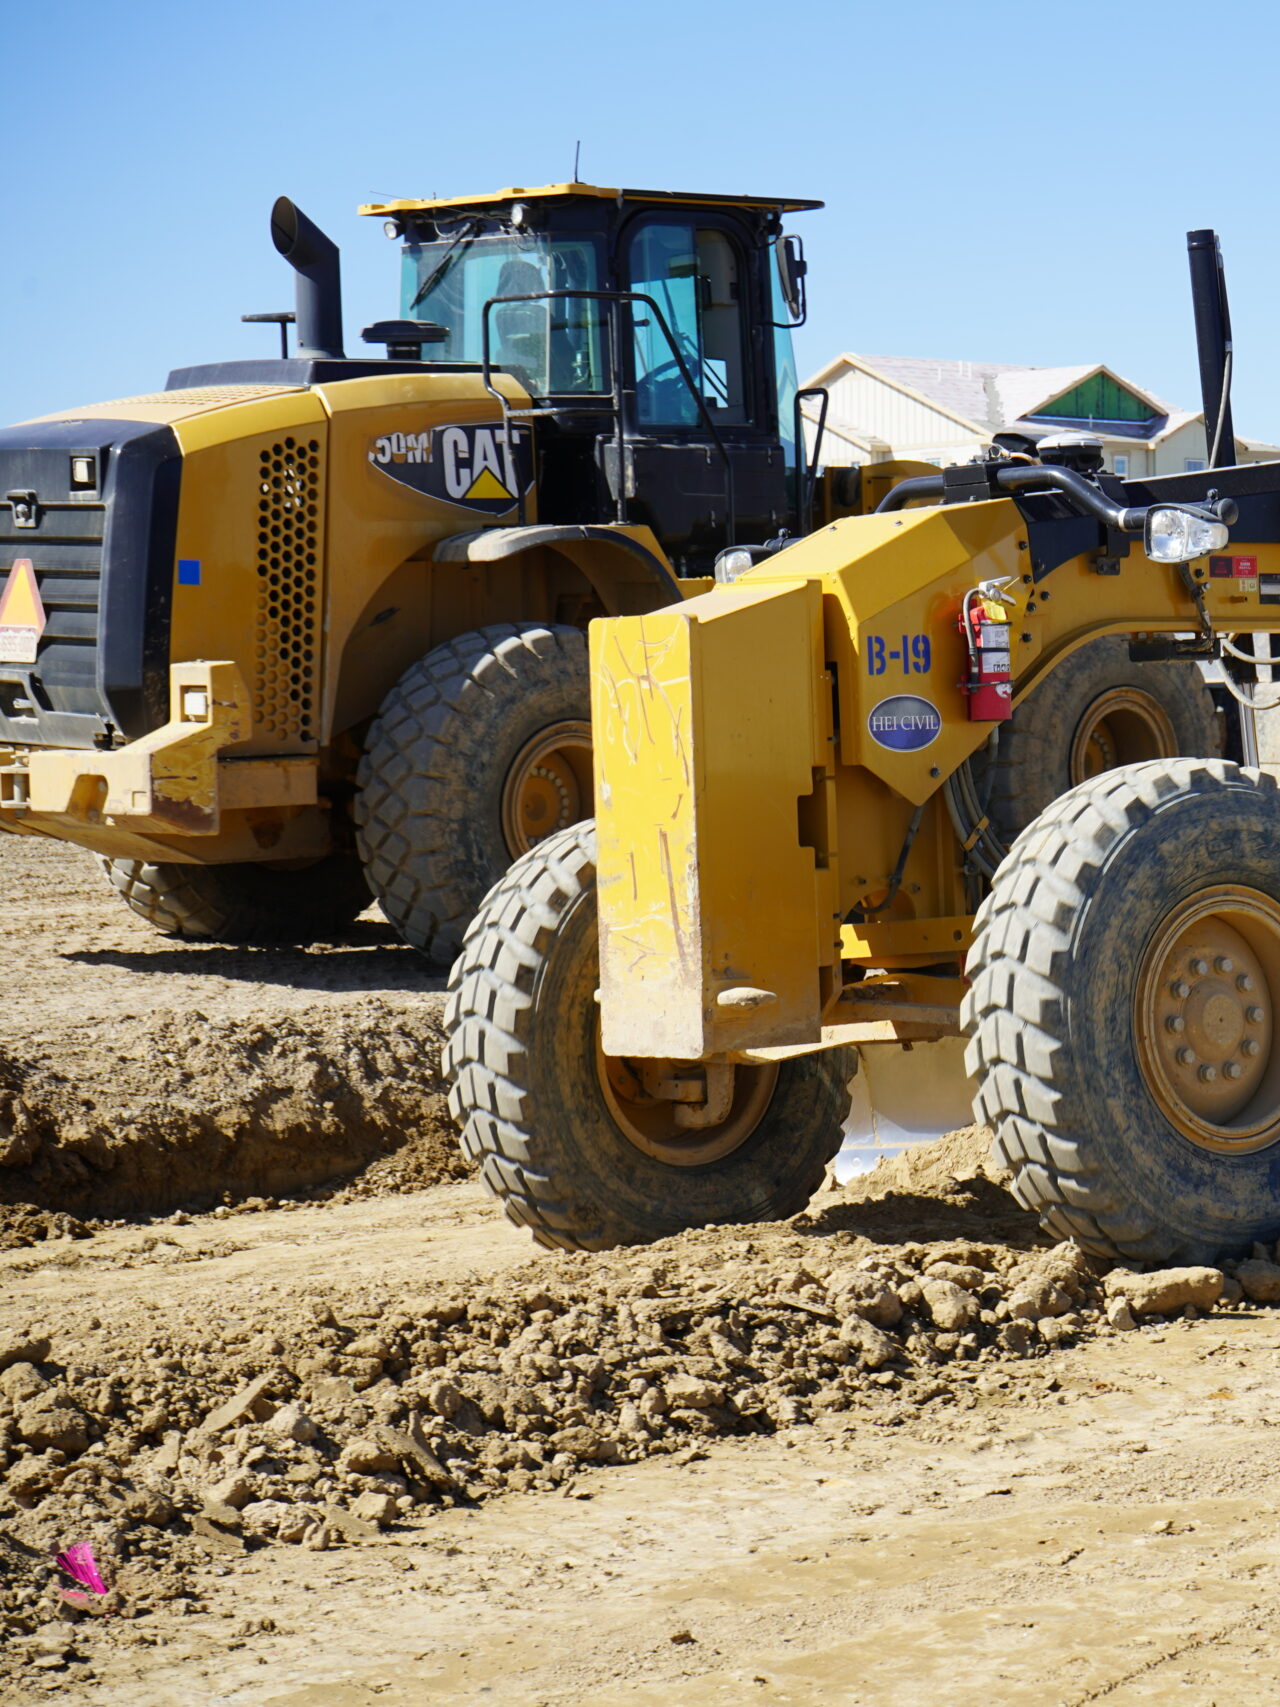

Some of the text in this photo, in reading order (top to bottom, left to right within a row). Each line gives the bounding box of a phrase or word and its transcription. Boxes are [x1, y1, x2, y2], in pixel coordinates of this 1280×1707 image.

[443, 427, 521, 499] CAT
[867, 634, 931, 675] B-19
[872, 715, 939, 731] HEI CIVIL
